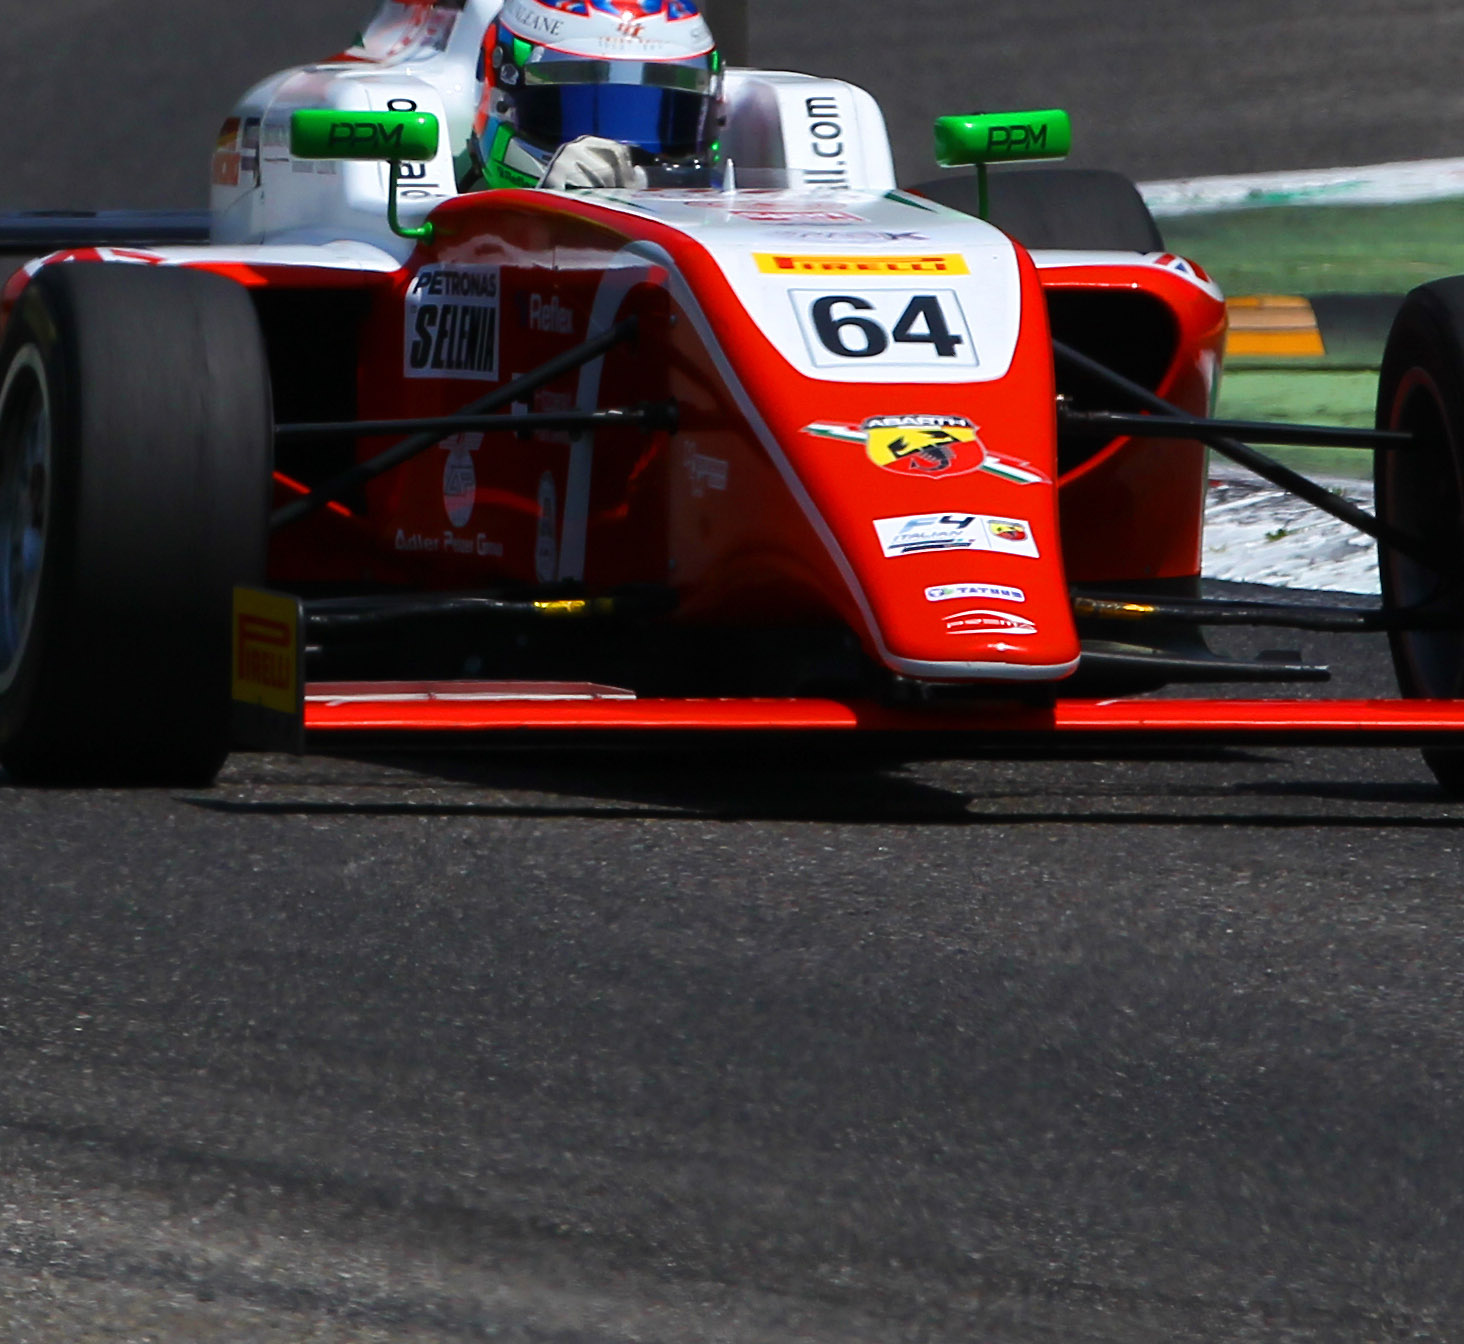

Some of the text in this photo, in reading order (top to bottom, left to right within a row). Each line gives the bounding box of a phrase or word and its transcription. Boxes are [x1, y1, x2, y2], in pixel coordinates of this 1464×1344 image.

[328, 122, 404, 149] PPM
[986, 123, 1049, 153] PPM
[412, 270, 497, 298] PETRONAS
[811, 294, 964, 358] 64
